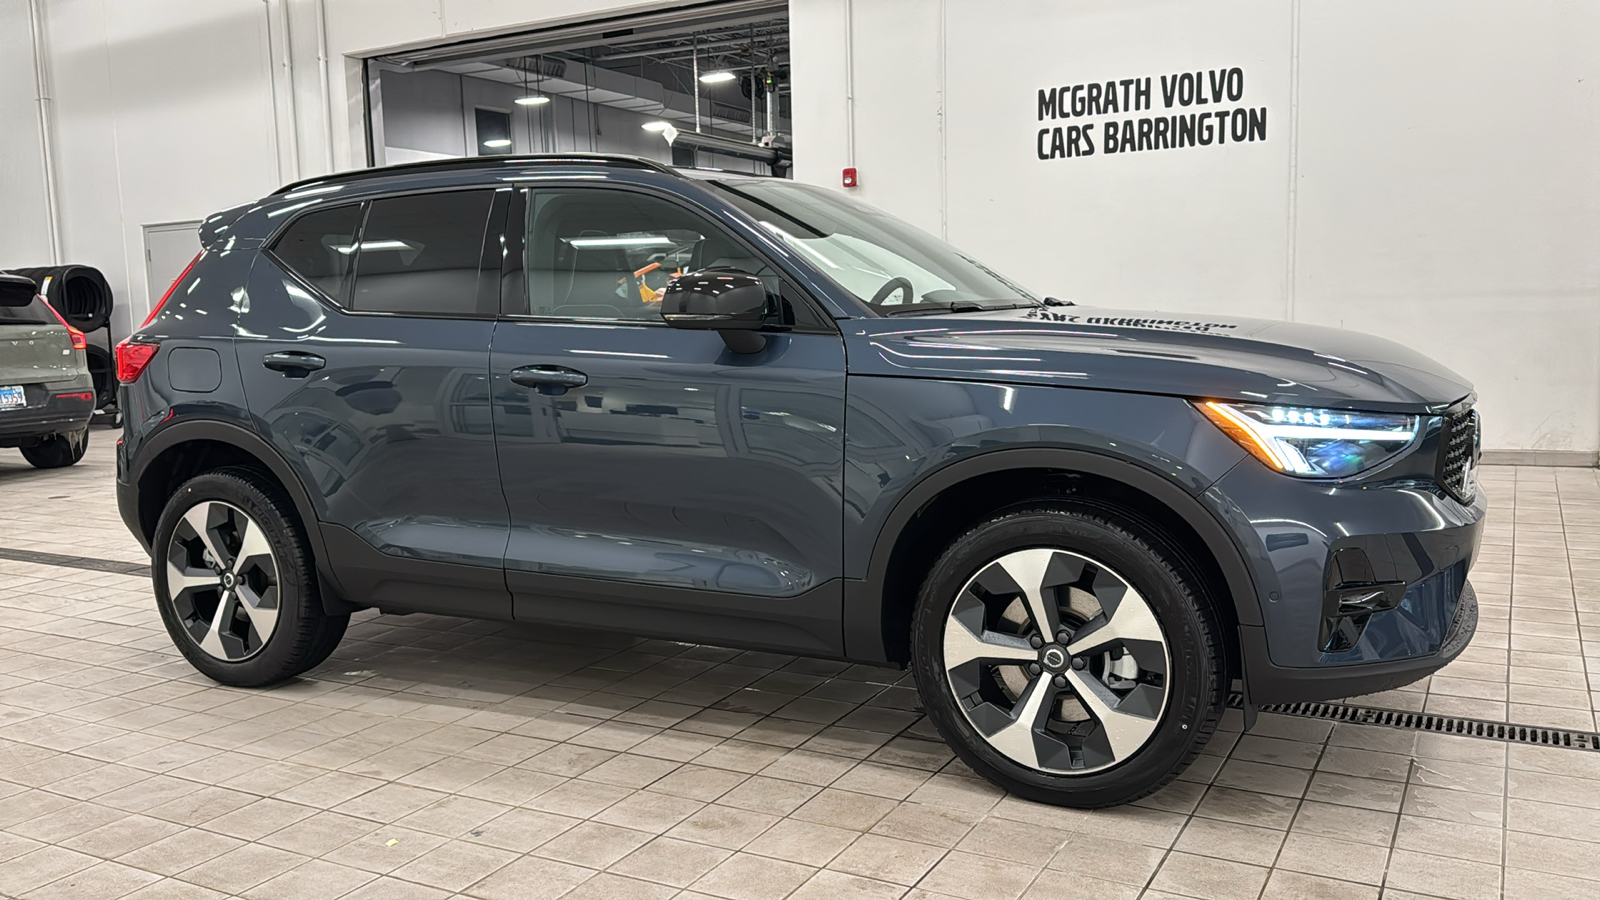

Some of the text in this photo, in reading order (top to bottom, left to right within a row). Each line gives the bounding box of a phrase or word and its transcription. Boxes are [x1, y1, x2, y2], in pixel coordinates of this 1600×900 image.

[1038, 67, 1243, 121] MCGRATH VOLVO
[1037, 106, 1267, 160] CARS BARRINGTON
